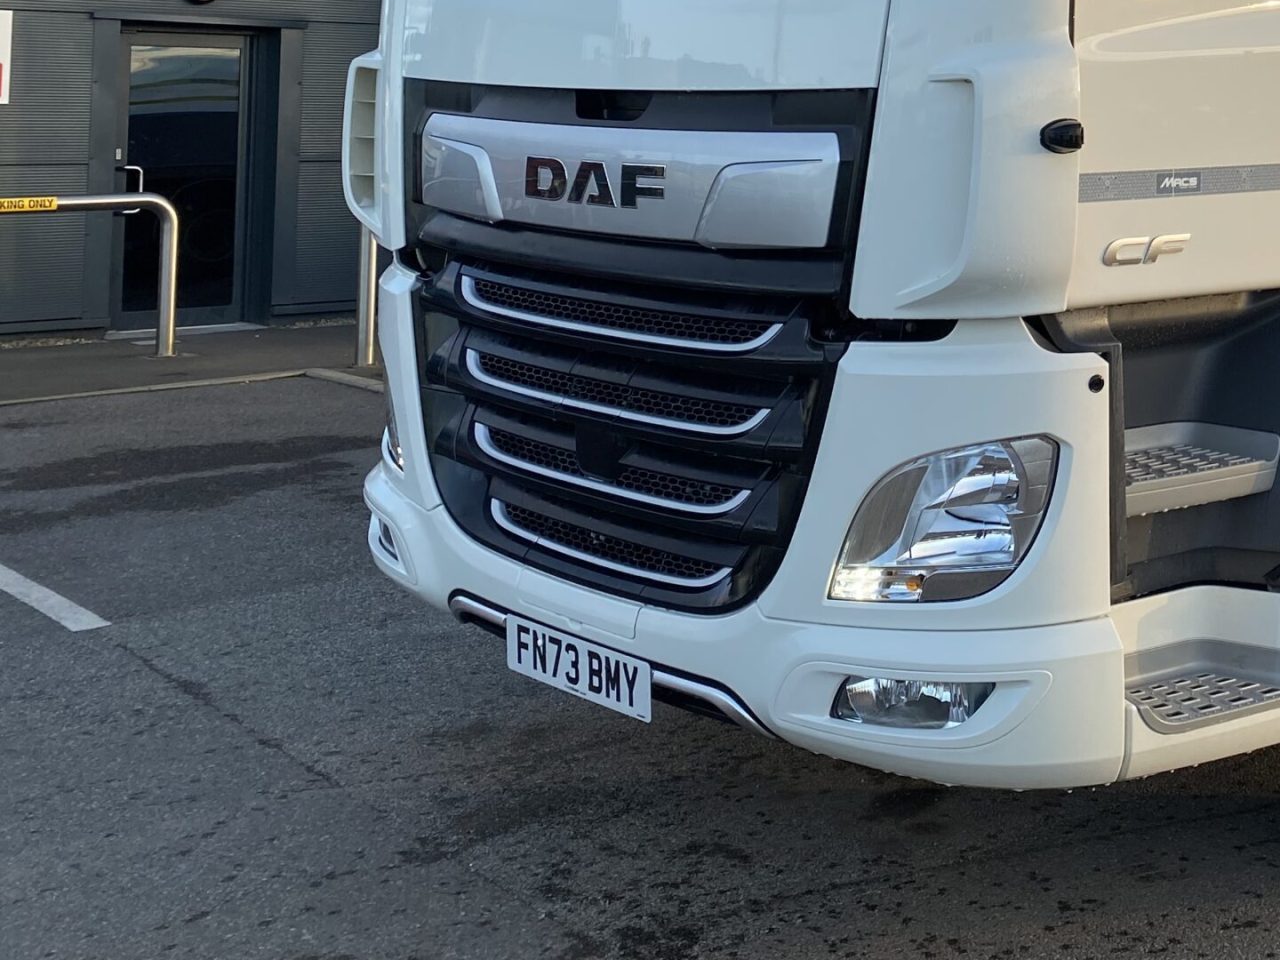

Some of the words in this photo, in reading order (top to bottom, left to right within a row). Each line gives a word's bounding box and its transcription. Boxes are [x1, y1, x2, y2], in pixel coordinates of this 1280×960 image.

[525, 155, 667, 209] DAF
[1160, 177, 1198, 188] MACS
[29, 199, 54, 208] ONLY
[1102, 234, 1191, 267] CF
[517, 624, 579, 685] FN73
[588, 650, 638, 707] BMY
